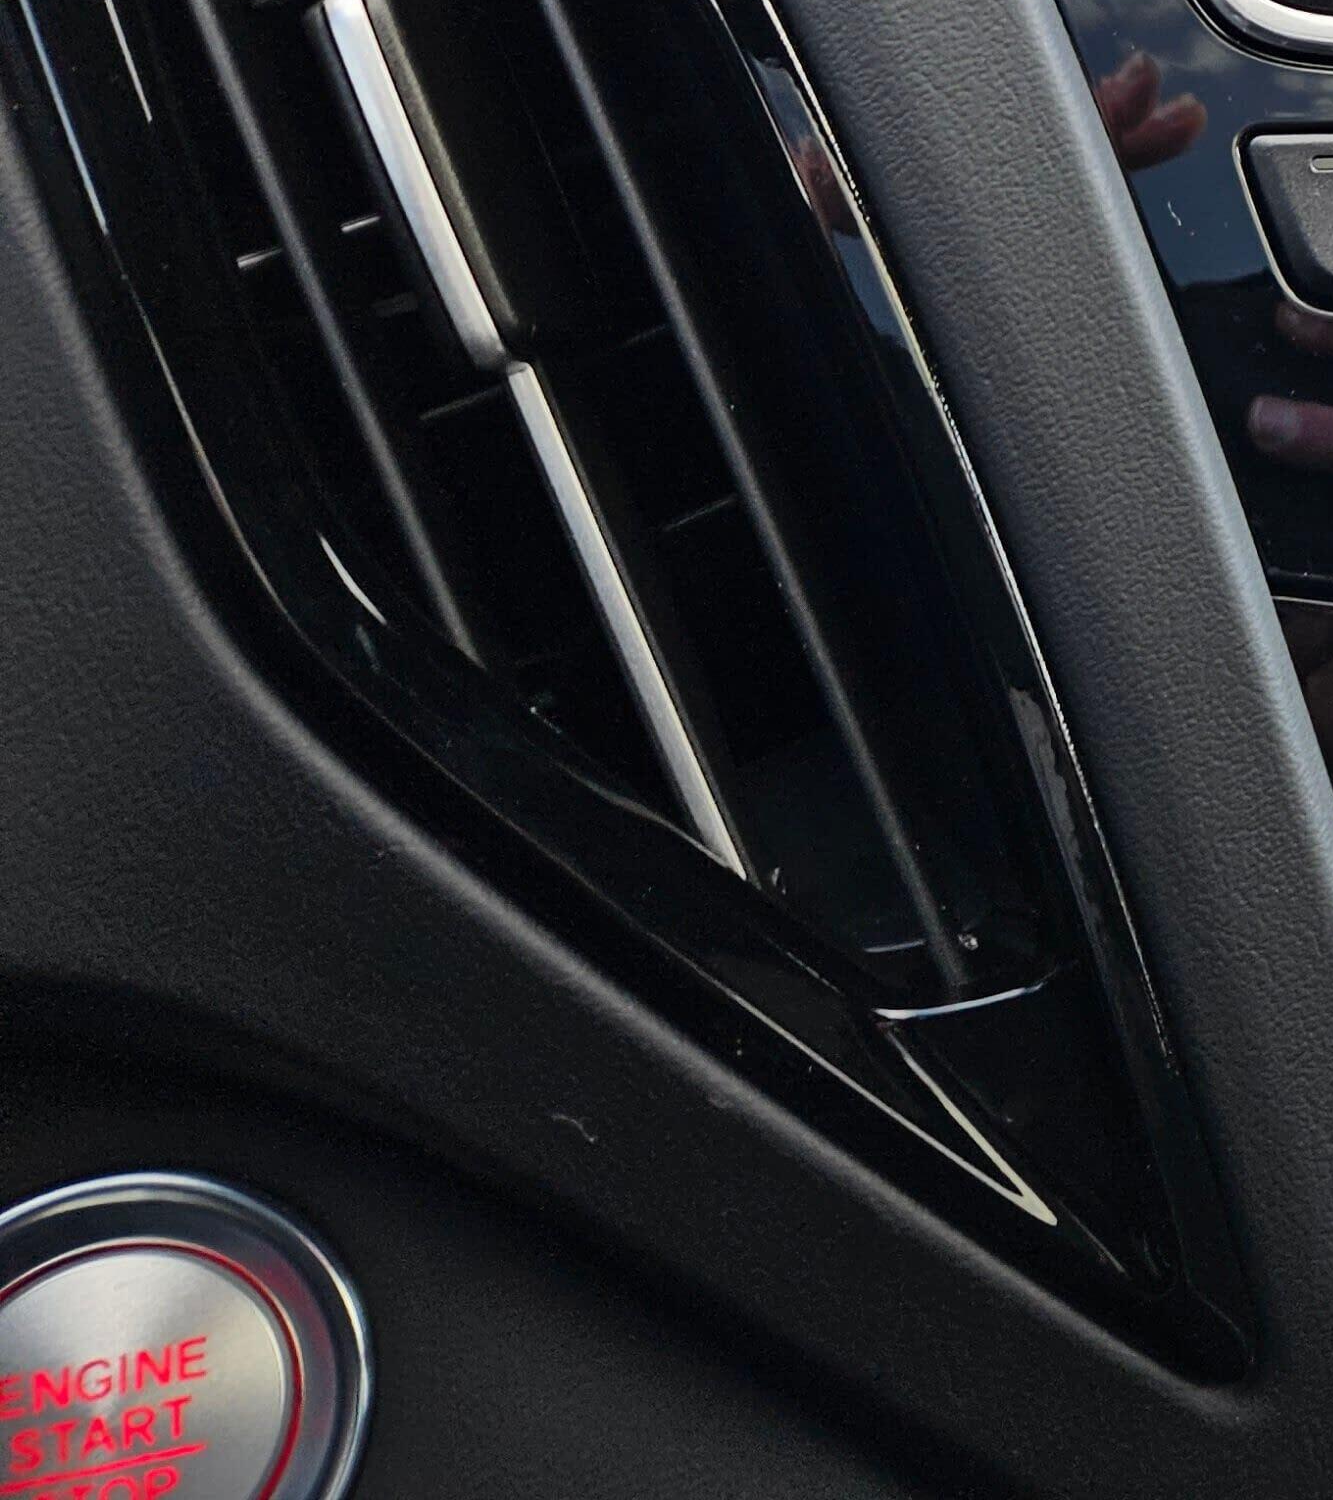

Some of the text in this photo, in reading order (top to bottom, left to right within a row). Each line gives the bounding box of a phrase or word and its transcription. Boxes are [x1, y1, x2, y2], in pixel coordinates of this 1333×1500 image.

[0, 1336, 207, 1420] ENGINE
[9, 1395, 192, 1474] START
[33, 1466, 180, 1500] OP
